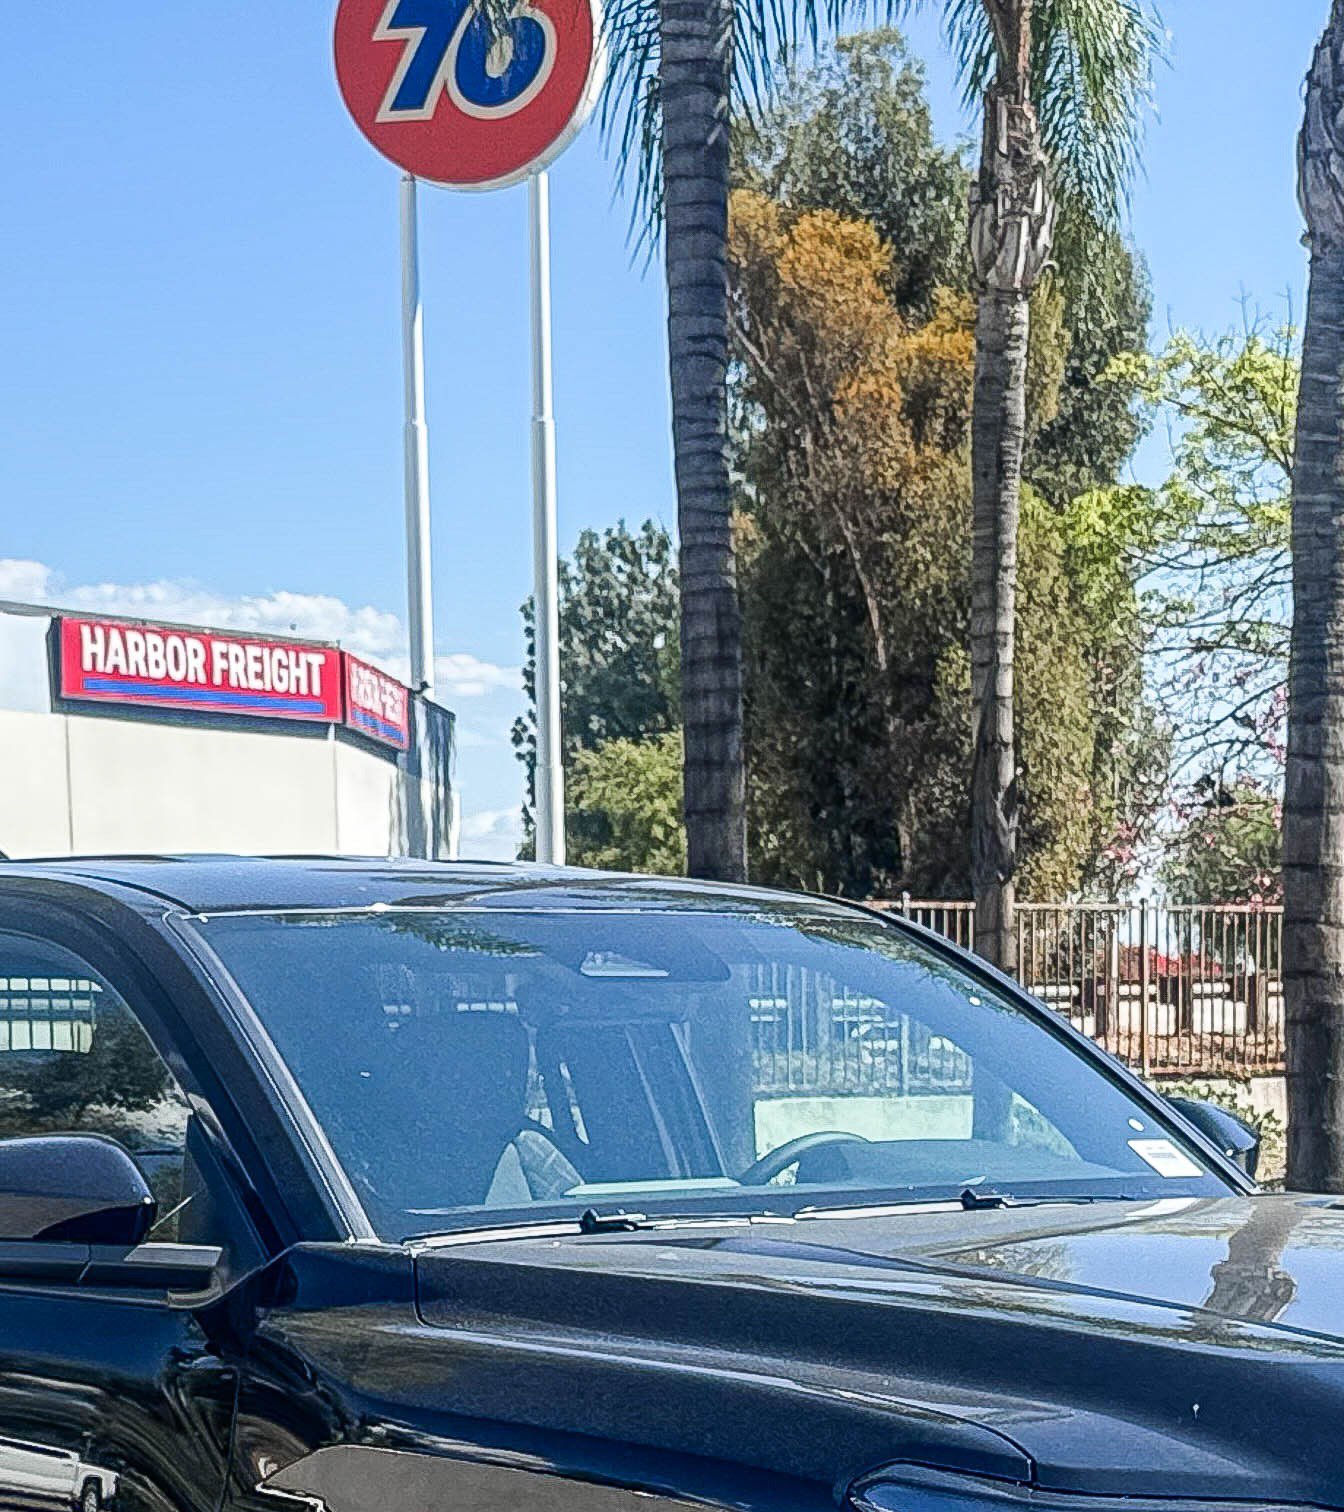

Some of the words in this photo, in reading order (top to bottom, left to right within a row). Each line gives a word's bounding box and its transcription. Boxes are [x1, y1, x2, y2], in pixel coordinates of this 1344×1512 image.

[376, 0, 555, 122] 76
[79, 623, 208, 685] HARBOR
[209, 639, 326, 697] FREIGHT
